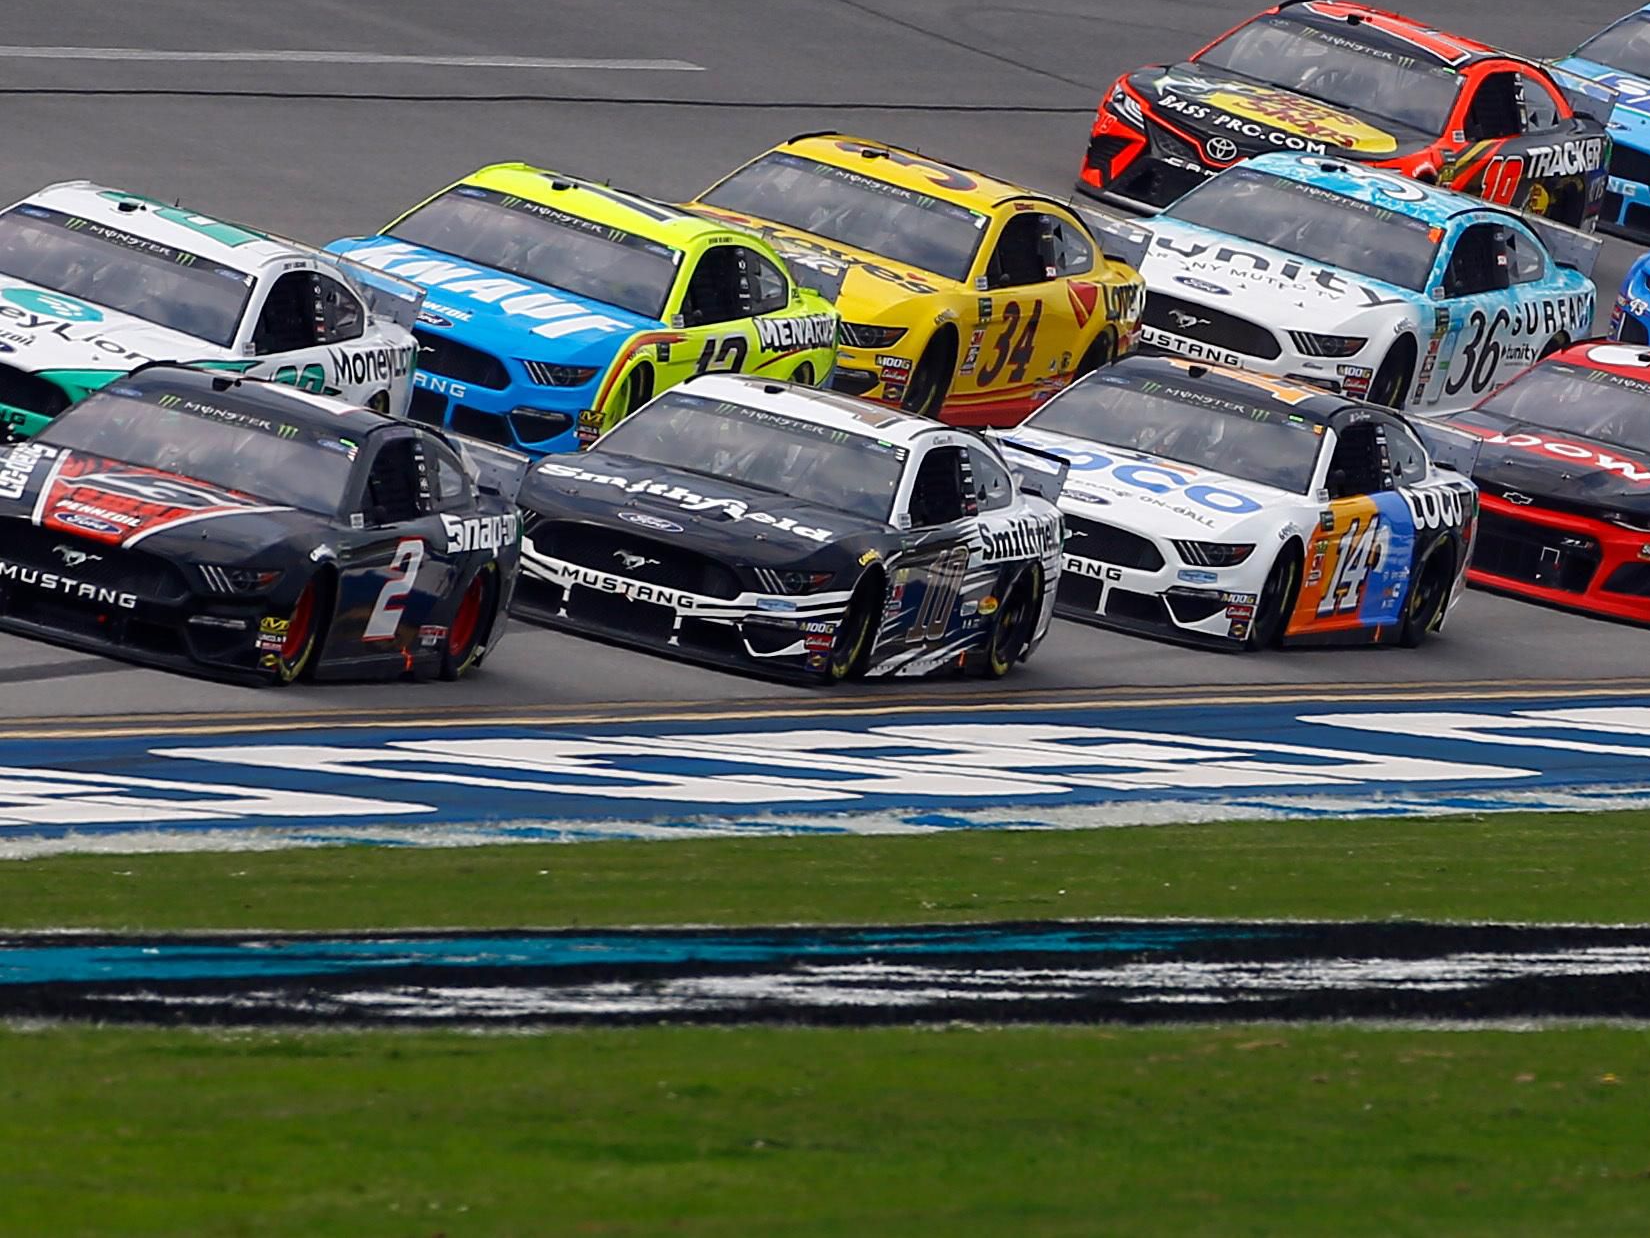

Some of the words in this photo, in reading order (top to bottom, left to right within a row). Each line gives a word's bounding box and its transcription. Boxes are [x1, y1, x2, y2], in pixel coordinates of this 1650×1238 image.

[1164, 156, 1220, 178] CAM
[1526, 138, 1603, 180] TRACKER
[89, 224, 171, 256] MONSTER
[756, 311, 838, 353] MENARDS
[976, 299, 1042, 388] 34
[1141, 328, 1240, 367] USTANG
[1445, 309, 1511, 396] 36
[184, 402, 272, 430] MONSTER
[56, 499, 143, 528] PENNZOIL
[560, 564, 697, 609] MUSTANG
[1315, 514, 1380, 616] 14
[0, 564, 137, 610] MUSTANG
[361, 536, 425, 643] 2
[904, 546, 970, 644] 10
